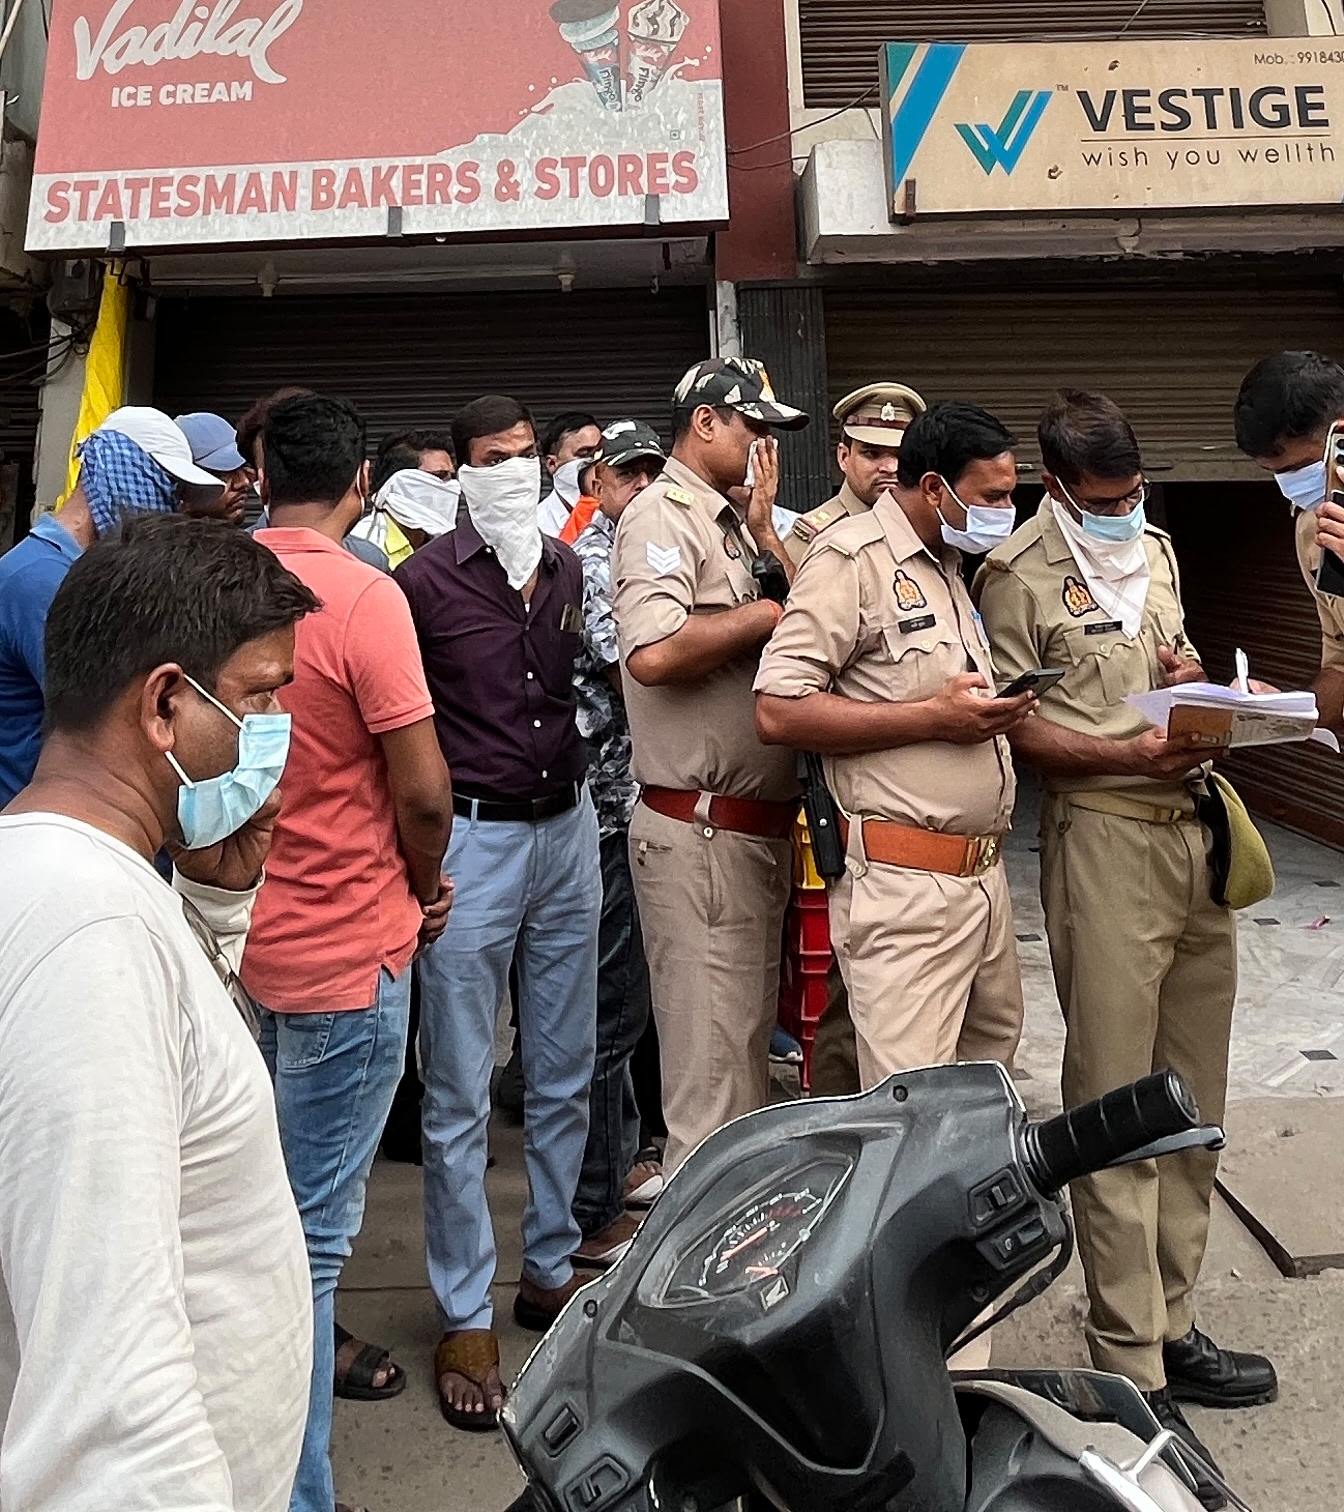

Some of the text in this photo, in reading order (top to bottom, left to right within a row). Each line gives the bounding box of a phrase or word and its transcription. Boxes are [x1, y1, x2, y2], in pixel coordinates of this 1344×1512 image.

[111, 81, 253, 109] ICE CREAM
[1076, 84, 1330, 133] VESTIGE
[1083, 141, 1335, 170] wish you wellth
[43, 150, 700, 224] STATESMAN BAKERS & STORES
